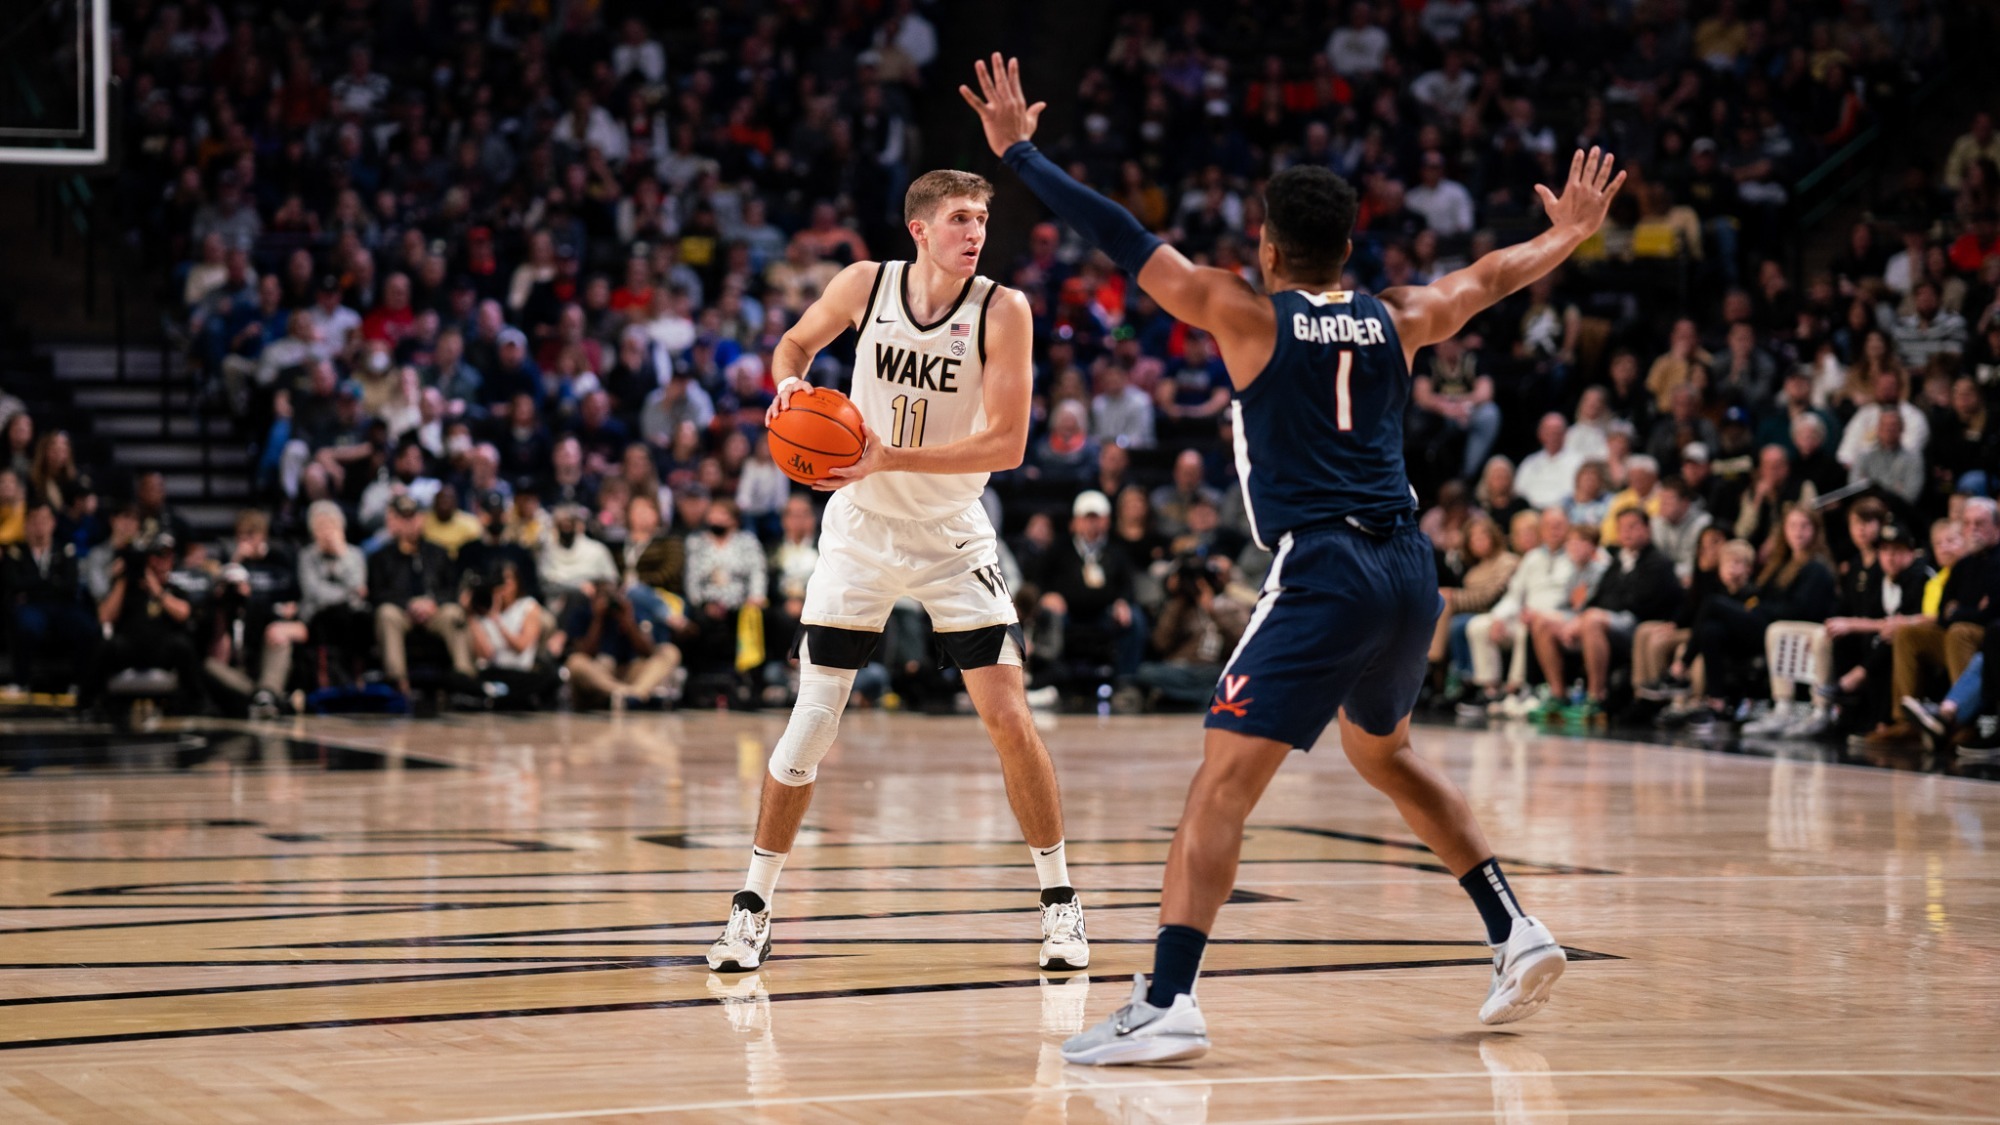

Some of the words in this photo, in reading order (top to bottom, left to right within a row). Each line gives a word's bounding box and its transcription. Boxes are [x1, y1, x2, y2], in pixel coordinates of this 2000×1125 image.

[876, 343, 961, 393] WAKE
[1336, 350, 1352, 431] 1
[891, 394, 928, 448] 11
